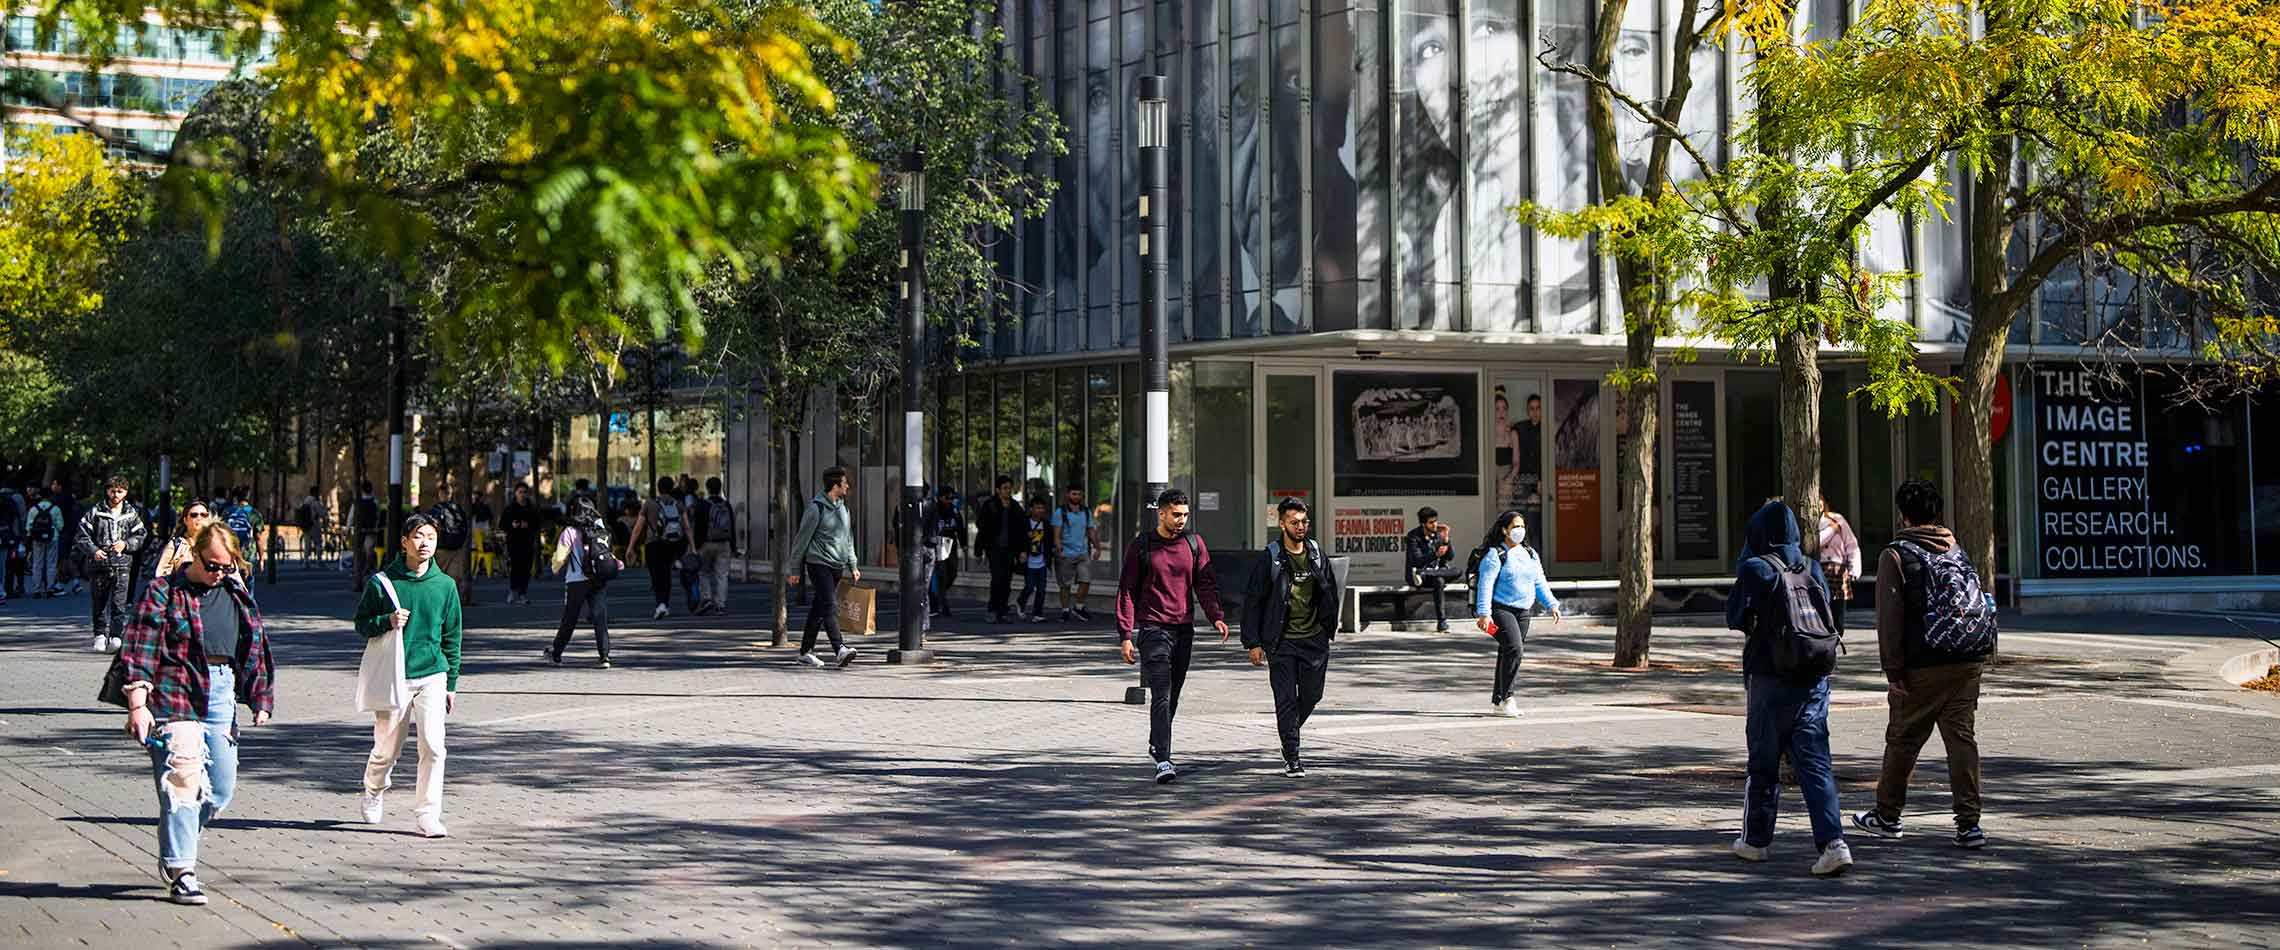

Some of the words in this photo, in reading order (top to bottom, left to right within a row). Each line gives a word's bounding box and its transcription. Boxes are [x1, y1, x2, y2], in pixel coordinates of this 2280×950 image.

[2040, 371, 2092, 397] THE
[2046, 405, 2132, 432] IMAGE
[2042, 440, 2150, 467] CENTRE
[2043, 476, 2150, 501] GALLERY.
[1335, 518, 1371, 536] DEANNA
[1373, 518, 1404, 535] BOWEN
[2044, 511, 2175, 536] RESEARCH.
[1335, 536, 1364, 553] BLACK
[1365, 536, 1400, 552] DRONES
[2046, 545, 2208, 570] COLLECTIONS.
